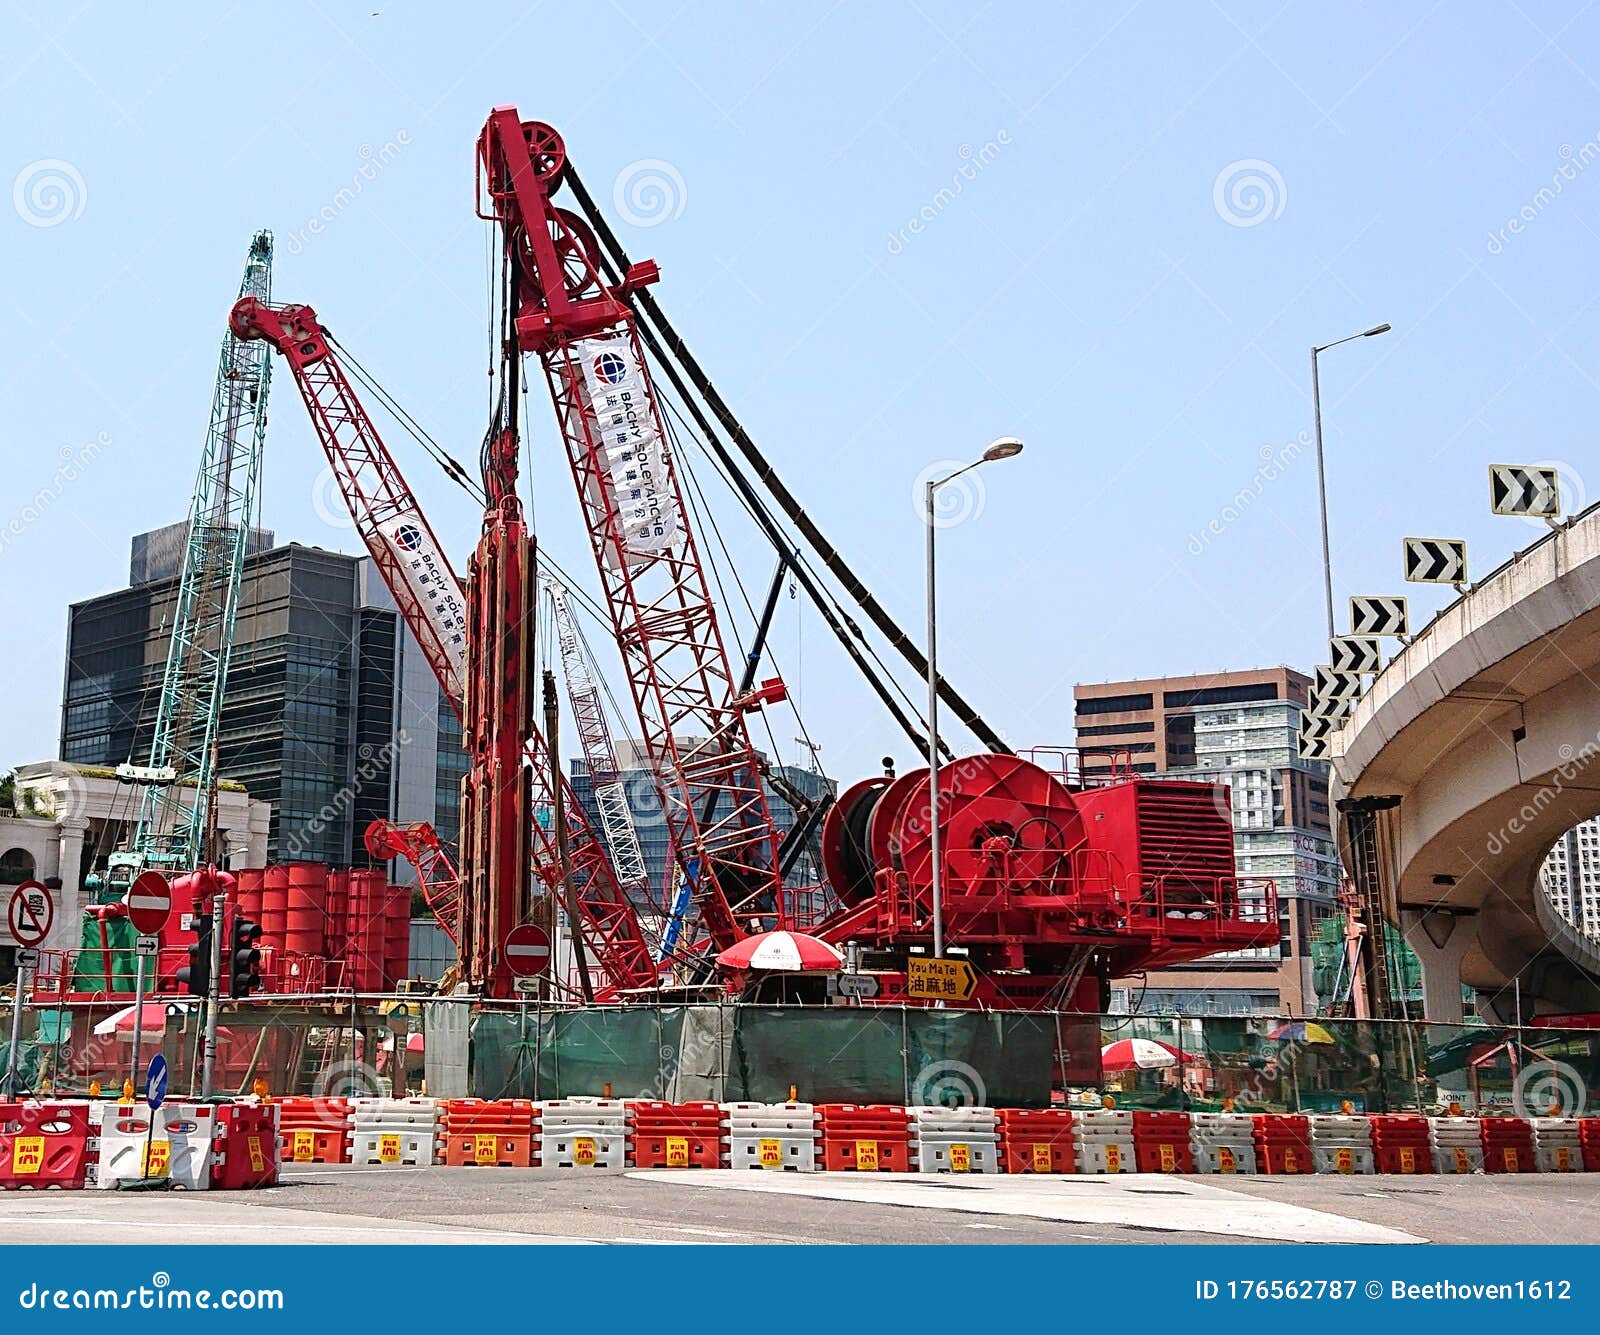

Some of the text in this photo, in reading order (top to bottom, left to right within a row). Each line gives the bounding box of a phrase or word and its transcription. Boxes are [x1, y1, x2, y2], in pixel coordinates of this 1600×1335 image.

[620, 391, 642, 438] BACHY
[421, 554, 449, 592] BACHY
[909, 961, 957, 976] Yau Ma Tei
[910, 975, 957, 995] 油麻地
[1441, 1093, 1468, 1102] JOINT
